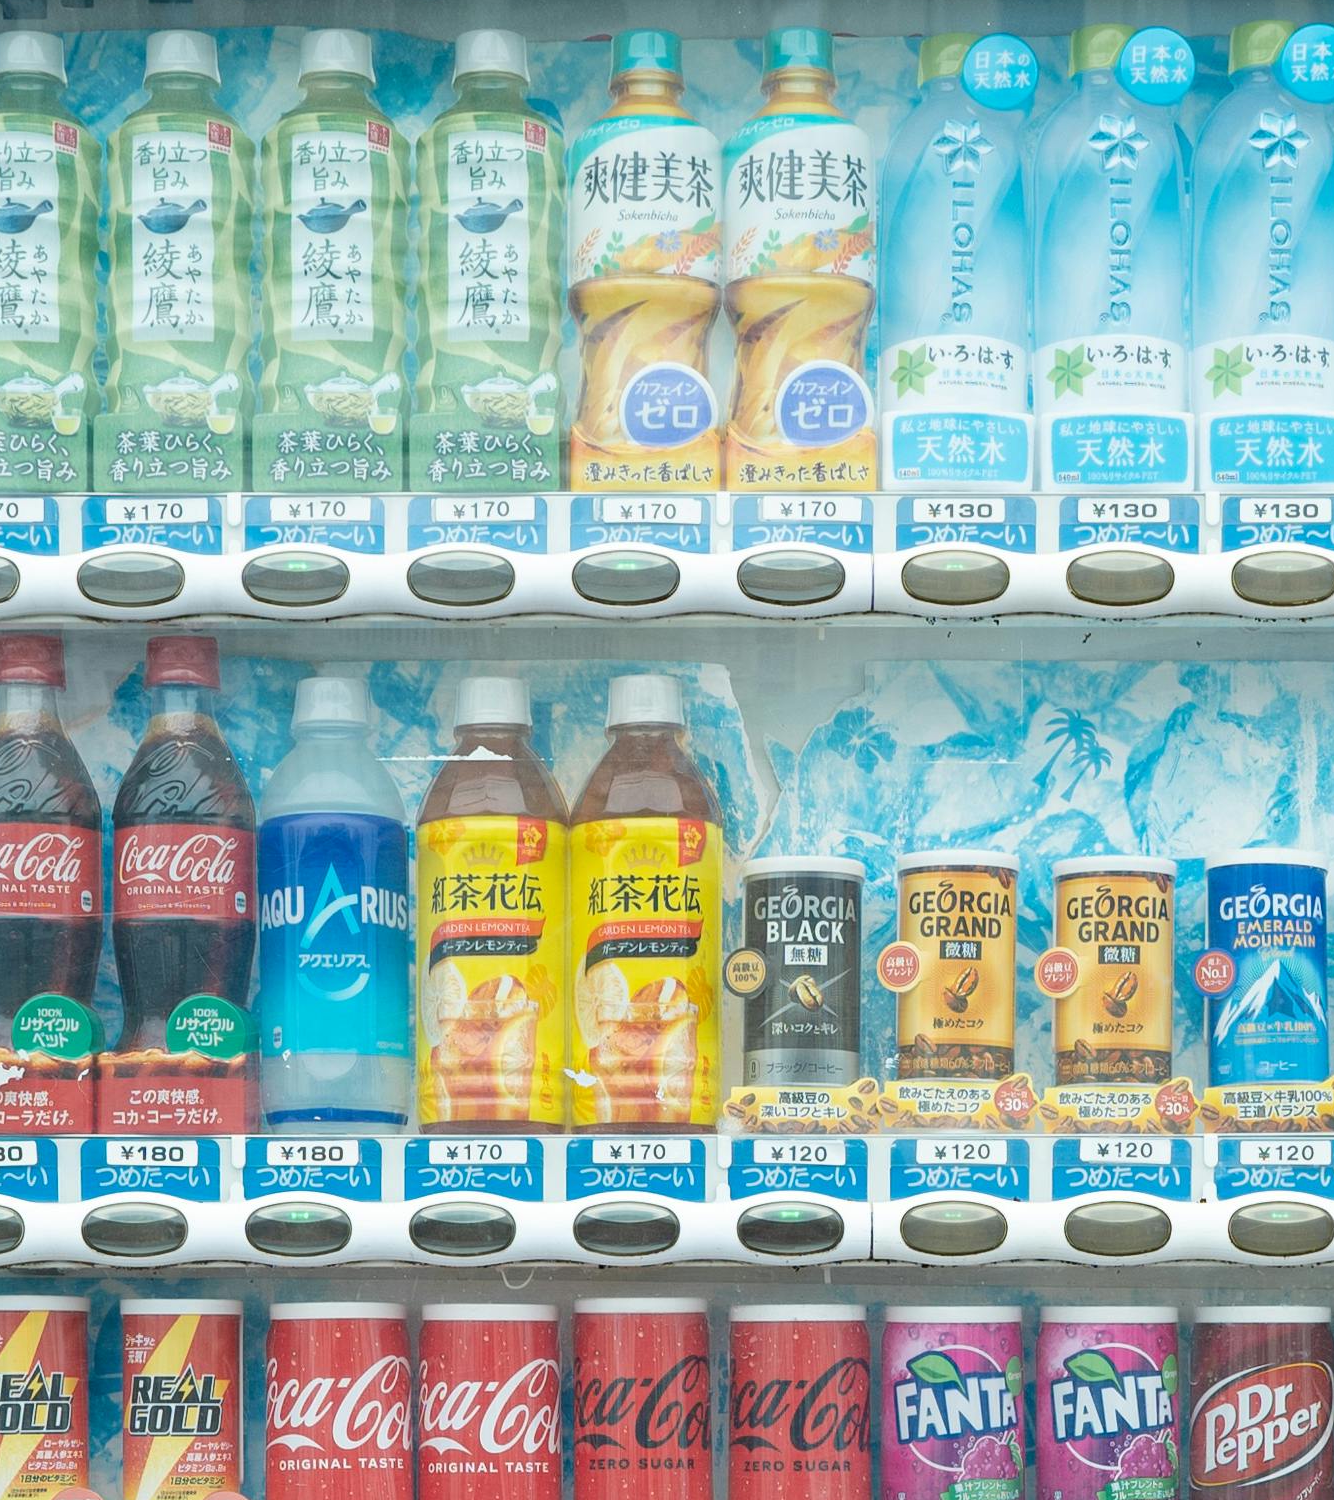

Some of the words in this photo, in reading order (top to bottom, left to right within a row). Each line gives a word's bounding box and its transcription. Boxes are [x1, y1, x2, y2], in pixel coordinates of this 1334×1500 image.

[974, 50, 1030, 68] 日本の
[974, 71, 1031, 89] 天然水
[584, 153, 713, 209] 爽健美茶
[739, 153, 868, 209] 爽健美茶
[616, 208, 678, 222] Sokenbicha
[33, 244, 51, 327] あやたか
[302, 240, 342, 329] 綾鷹
[633, 381, 698, 397] カフェイン
[634, 399, 698, 430] ゼロ
[790, 399, 854, 430] ゼロ
[900, 417, 1020, 435] 私と地球にやさしい
[435, 432, 542, 454] 茶葉ひらく、
[917, 435, 1006, 468] 天然水
[1237, 435, 1326, 468] 天然水
[107, 457, 232, 481] 香り立つ旨み
[269, 457, 393, 481] 香り立つ旨み
[584, 462, 713, 483] 澄みきった香ばしさ
[123, 503, 183, 521] ¥170
[453, 501, 510, 519] ¥170
[781, 501, 837, 517] ¥170
[929, 504, 992, 518] ¥130
[1093, 503, 1157, 518] ¥130
[118, 832, 236, 883] Coca-Cola
[32, 885, 71, 894] TASTE
[432, 875, 542, 913] 紅茶花伝
[590, 875, 700, 913] 紅茶花伝
[754, 884, 856, 921] GEORGIA
[909, 880, 1012, 917] GEORGIA
[1220, 884, 1323, 921] GEORGIA
[438, 923, 471, 936] GARDEN
[474, 921, 509, 934] LEMON
[767, 921, 844, 944] BLACK
[920, 916, 1001, 938] GRAND
[1238, 920, 1312, 935] EMERALD
[1233, 934, 1316, 948] MOUNTAIN
[791, 947, 822, 962] 無糖
[945, 943, 977, 959] 微糖
[299, 954, 368, 967] アクエリアス
[732, 963, 759, 973] 高級豆
[734, 974, 757, 982] 100%
[1201, 966, 1228, 979] No.1
[37, 1008, 65, 1018] 100%
[20, 1019, 79, 1032] リサイクル
[771, 1023, 838, 1035] 深いコクとキレ
[32, 1031, 70, 1047] ペット
[766, 1062, 843, 1074] ブラック/コーヒー
[779, 1092, 830, 1105] 高級豆の
[899, 1086, 991, 1100] 飲みごたえのある
[761, 1106, 847, 1119] 深いコクとキレ
[918, 1101, 980, 1113] 極めたコク
[1240, 1105, 1317, 1118] 王道バランス
[121, 1145, 184, 1162] ¥180
[281, 1146, 344, 1162] ¥180
[446, 1144, 502, 1160] ¥170
[772, 1145, 827, 1162] ¥120
[1098, 1142, 1153, 1158] ¥120
[131, 1363, 224, 1408] REAL
[895, 1374, 1017, 1442] FANTA
[1053, 1378, 1171, 1433] FANTA
[1237, 1383, 1293, 1430] Dr
[128, 1404, 224, 1436] GOLD
[1205, 1402, 1321, 1473] Pepper
[279, 1459, 352, 1470] ORIGINAL
[358, 1458, 404, 1469] TASTE
[589, 1459, 630, 1470] ZERO
[638, 1459, 695, 1470] SUGAR
